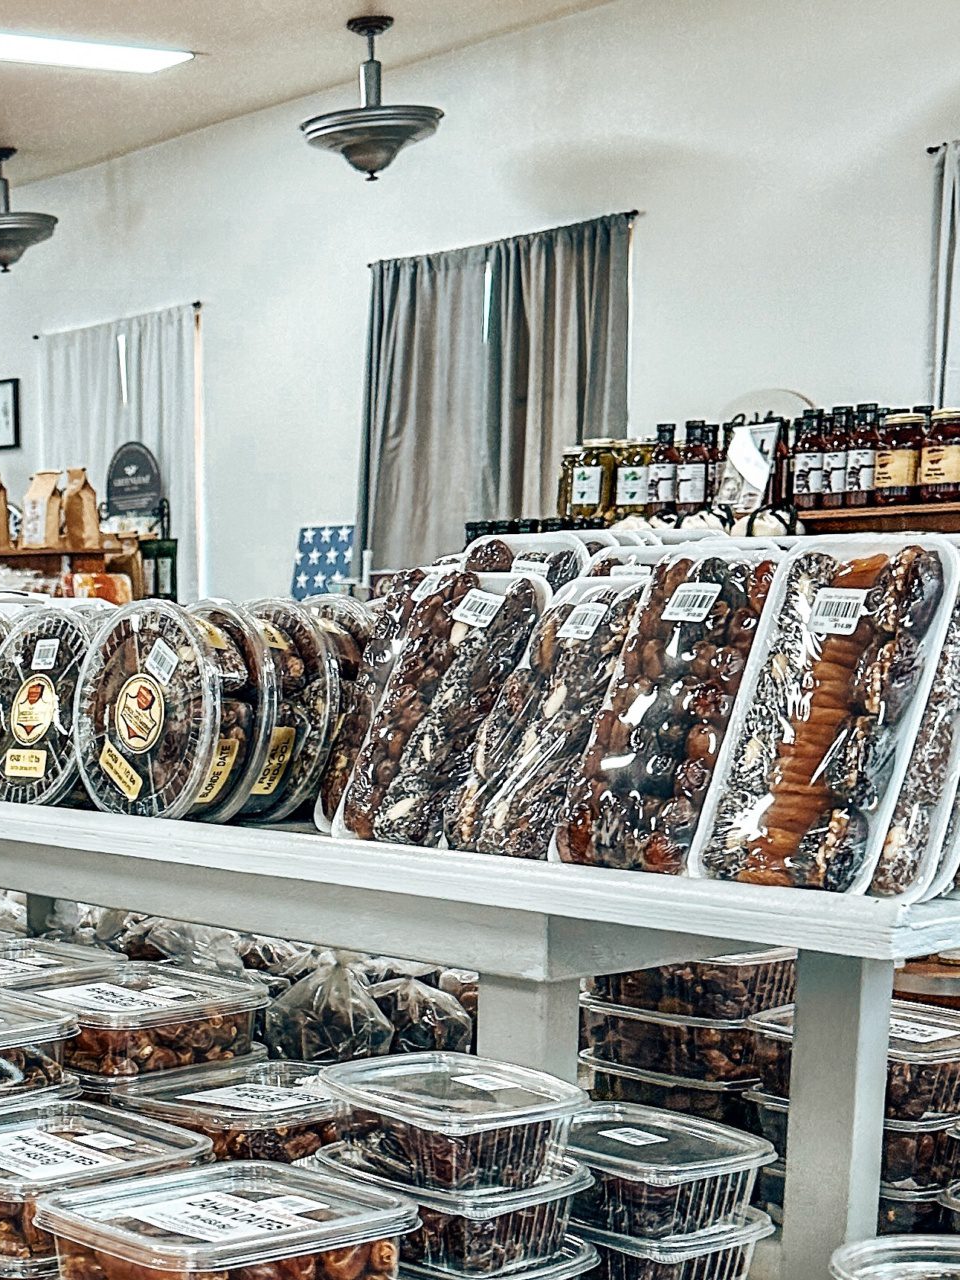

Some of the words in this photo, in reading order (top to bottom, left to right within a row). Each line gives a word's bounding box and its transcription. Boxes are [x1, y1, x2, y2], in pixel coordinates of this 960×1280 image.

[217, 744, 232, 768] DATE
[258, 745, 279, 784] ROYAL
[14, 1134, 61, 1153] HALAWI
[52, 1149, 100, 1166] DATES
[186, 1198, 245, 1218] ZAHIDI
[231, 1213, 293, 1230] DATES
